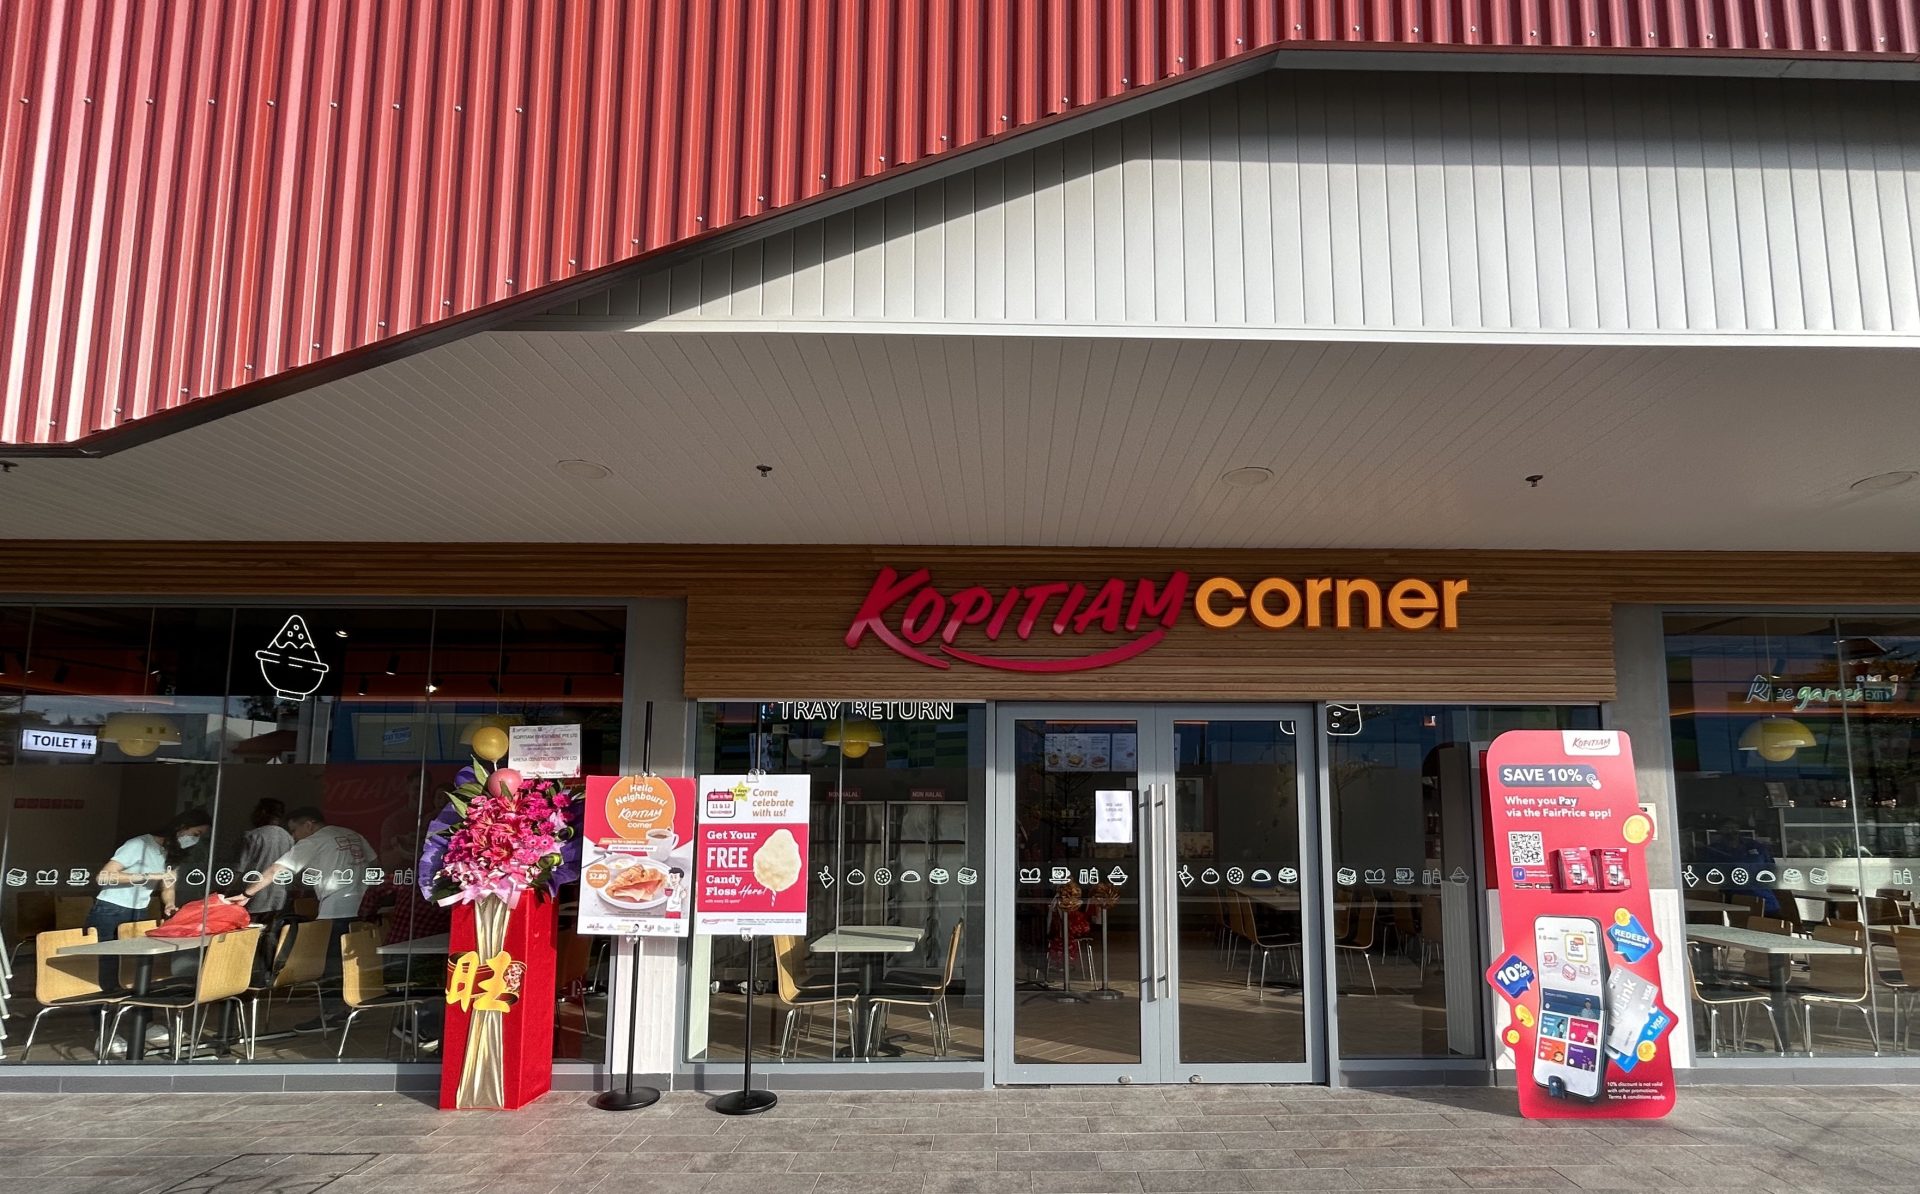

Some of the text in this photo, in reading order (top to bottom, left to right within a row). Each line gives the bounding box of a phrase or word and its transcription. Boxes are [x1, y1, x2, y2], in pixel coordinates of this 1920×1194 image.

[845, 566, 1470, 672] KOPITIAM corner
[1746, 675, 1794, 703] Rce
[1865, 690, 1885, 700] EXIT
[778, 700, 954, 720] TRAY RETURN
[32, 735, 78, 748] TOILET
[1572, 737, 1611, 750] KOPITIAM
[1503, 768, 1583, 782] SAVE 10%
[630, 784, 653, 793] Hello
[752, 788, 778, 797] Come
[615, 791, 668, 807] Neighbours!
[752, 798, 794, 807] celebrate
[1505, 796, 1577, 807] When you Pay
[618, 807, 663, 822] KOPITIAM
[752, 807, 787, 817] with us!
[1506, 808, 1611, 819] via the FairPrice app!
[707, 831, 757, 840] Get Your
[706, 847, 748, 868] FREE
[705, 875, 742, 886] Candy
[705, 884, 767, 898] Floss Here!
[1614, 928, 1650, 945] REDEEM
[1497, 961, 1528, 985] 10%
[1519, 969, 1531, 978] OFF
[1641, 984, 1655, 1001] VISA
[1650, 1014, 1665, 1031] VISA
